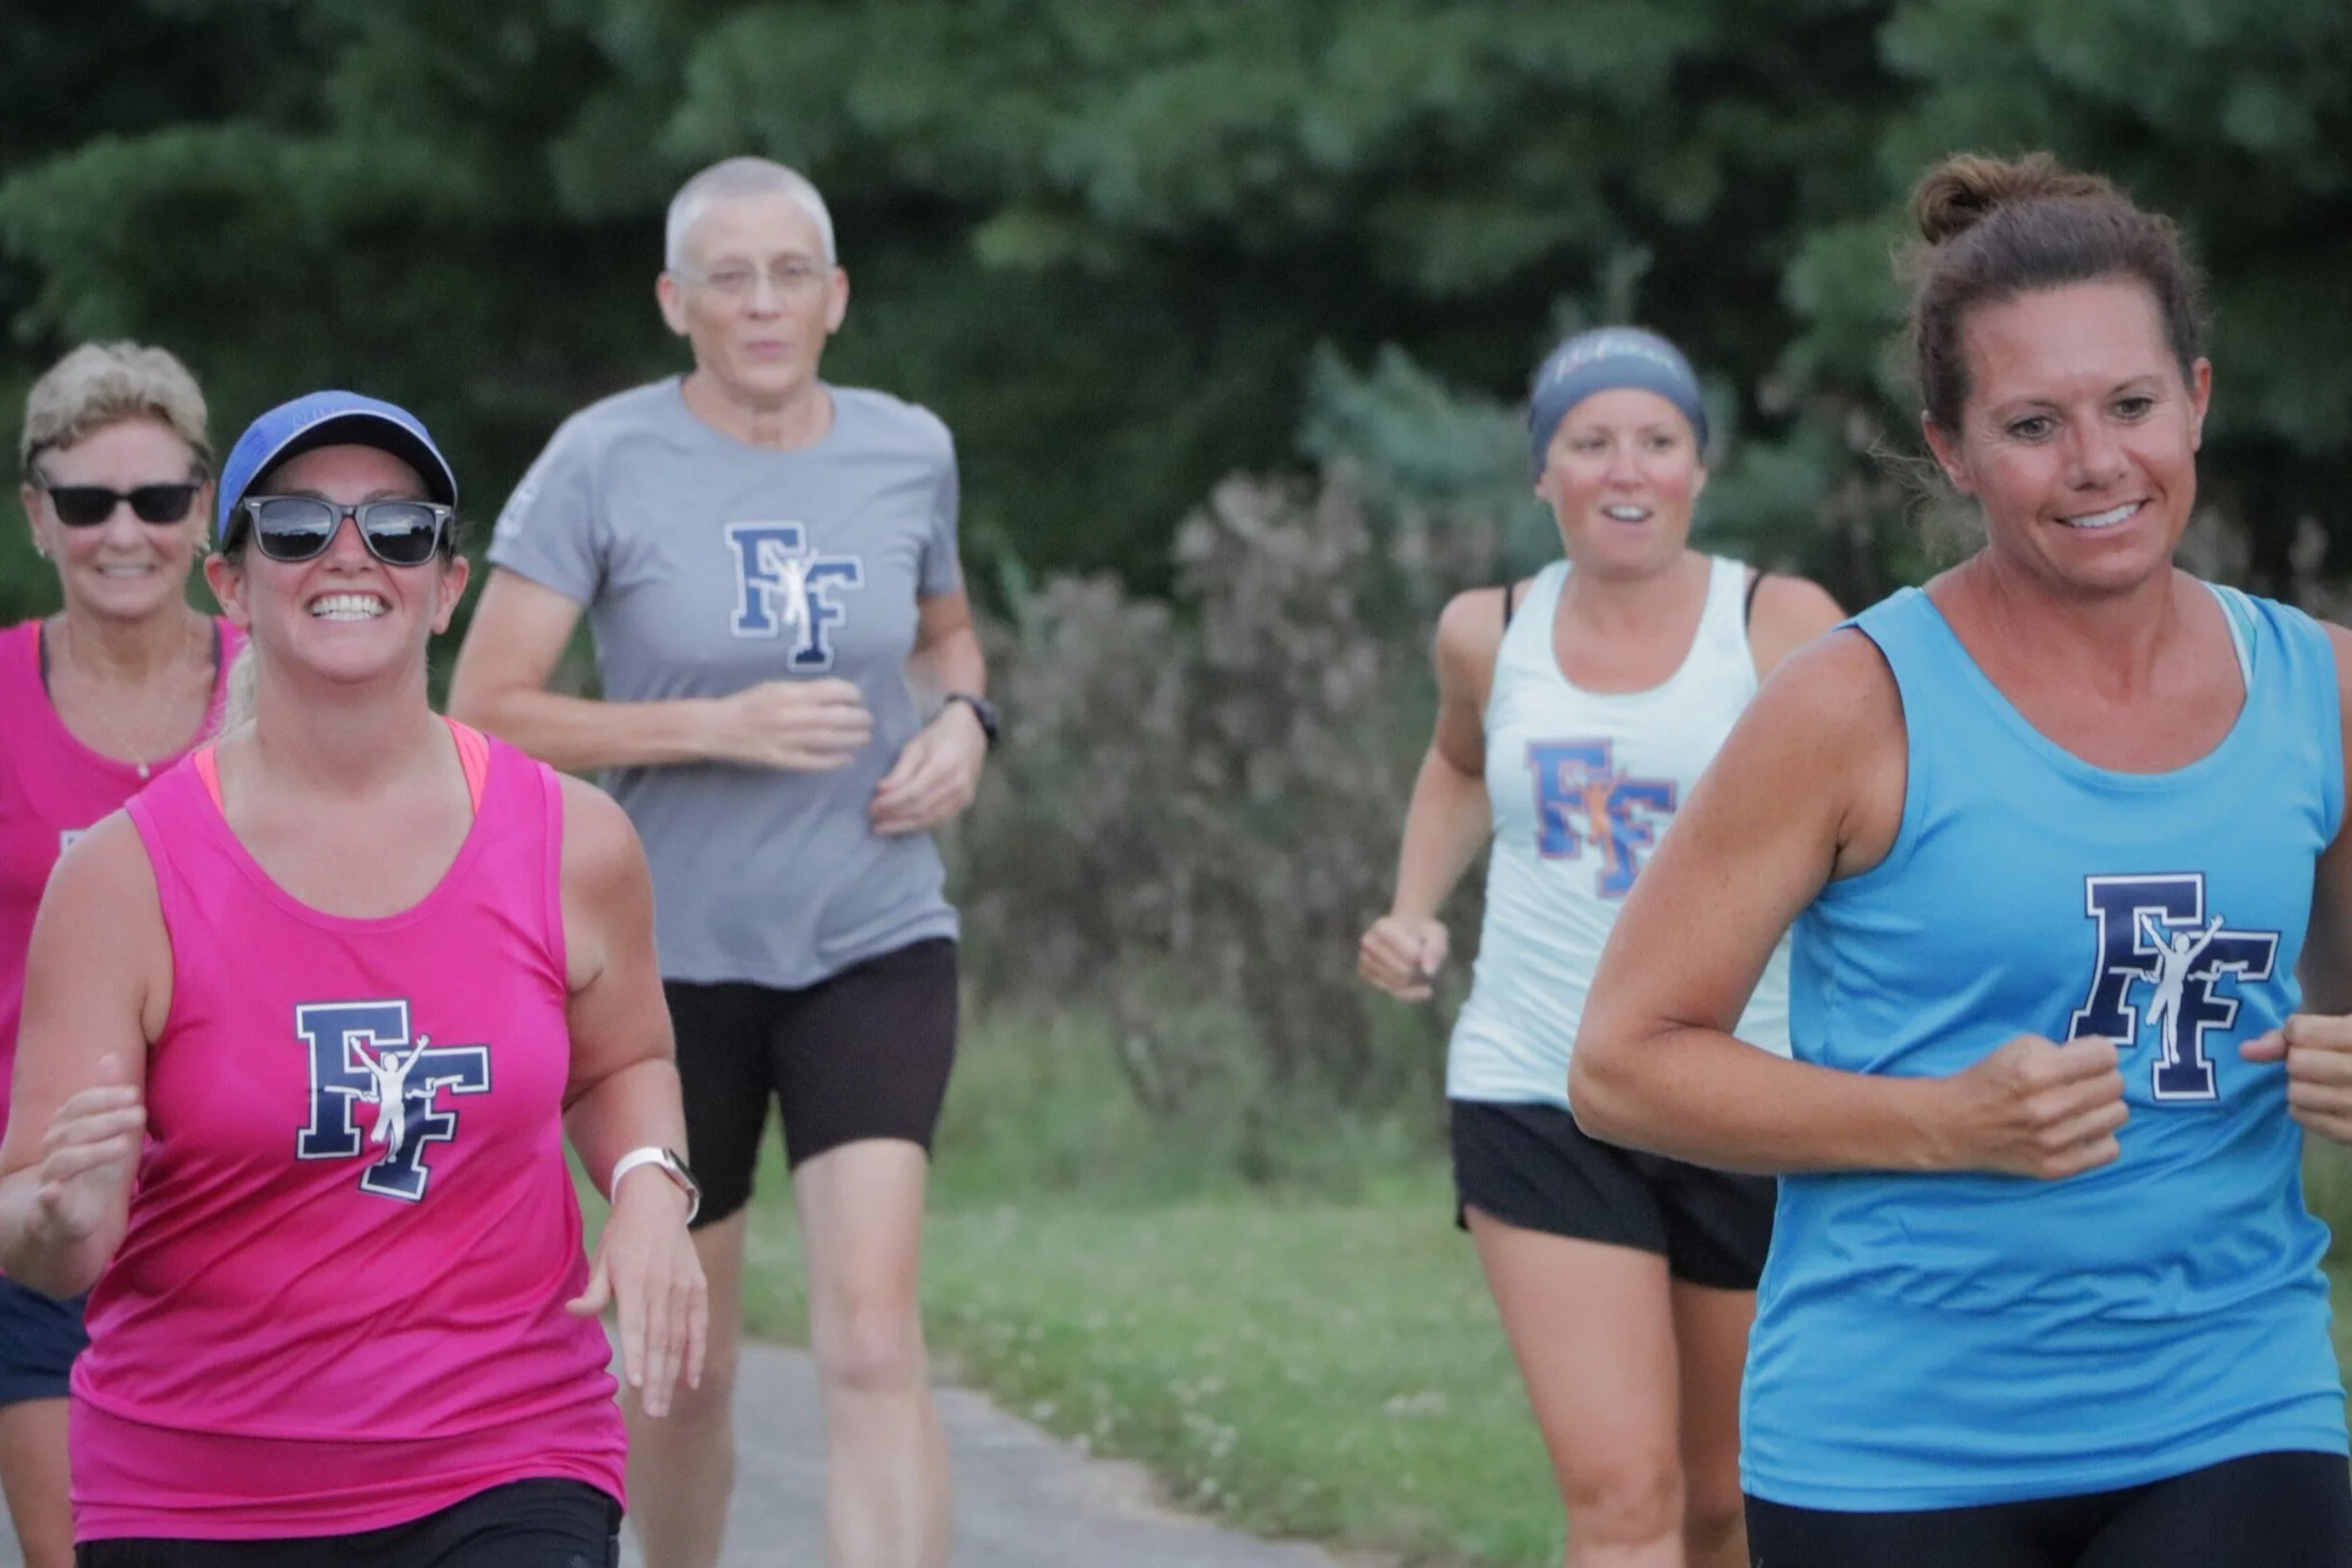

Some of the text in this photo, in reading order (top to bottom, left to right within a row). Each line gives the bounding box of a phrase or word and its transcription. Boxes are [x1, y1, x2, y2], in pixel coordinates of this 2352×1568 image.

[725, 520, 864, 670] FF
[2070, 872, 2280, 1102] FF
[296, 998, 489, 1201] FF
